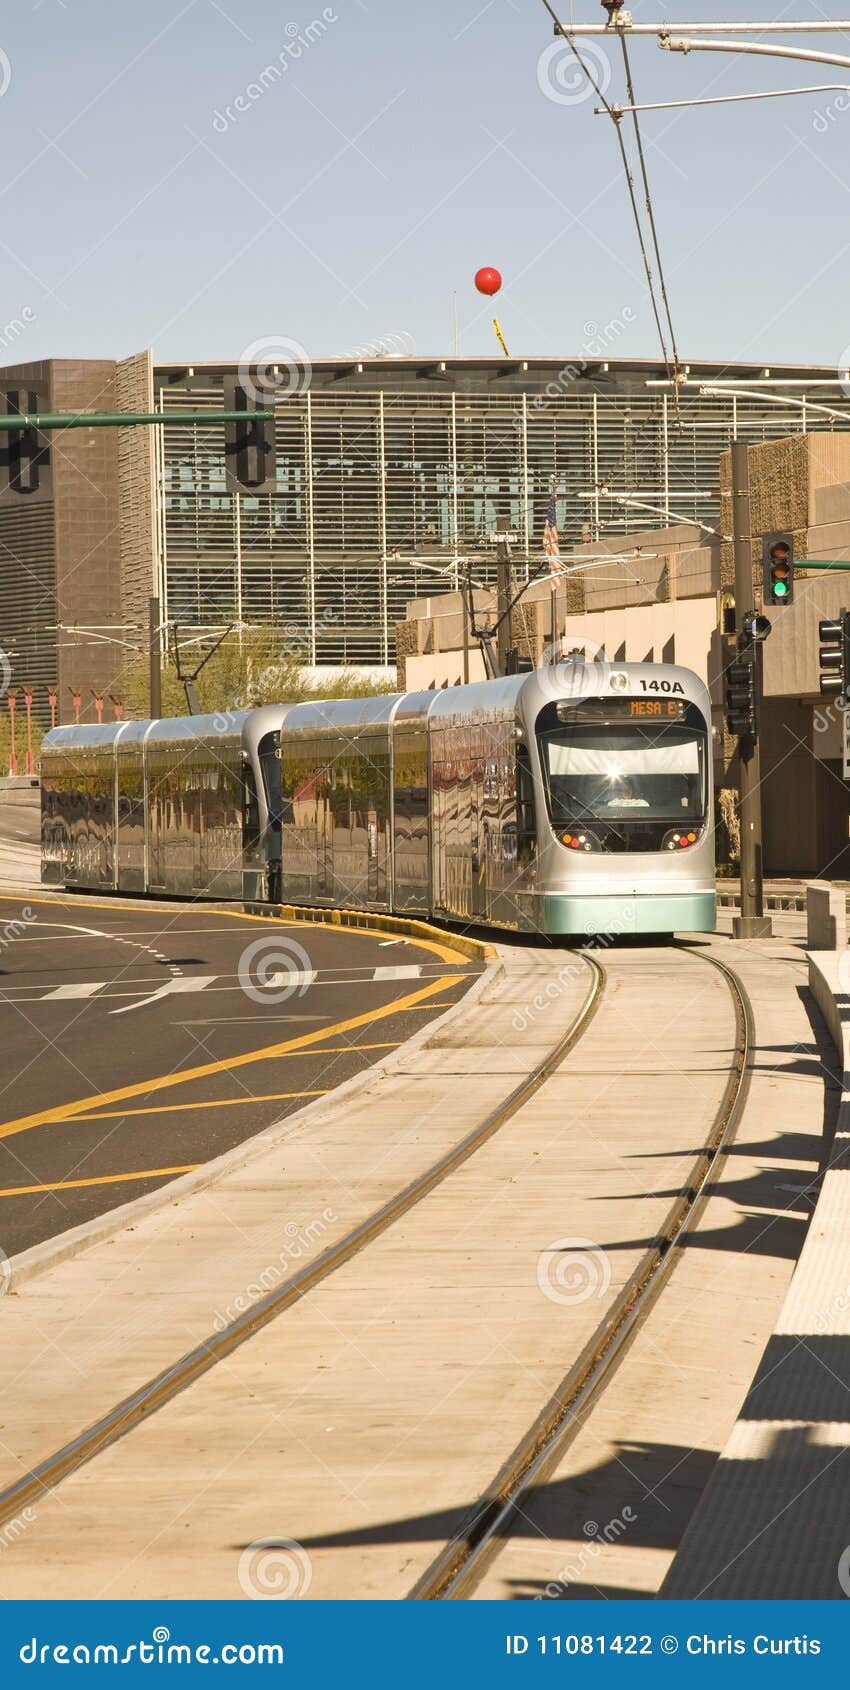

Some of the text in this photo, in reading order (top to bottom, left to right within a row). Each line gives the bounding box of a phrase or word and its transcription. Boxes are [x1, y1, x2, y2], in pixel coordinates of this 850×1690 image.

[639, 680, 685, 694] 140A
[630, 701, 676, 715] MESA E
